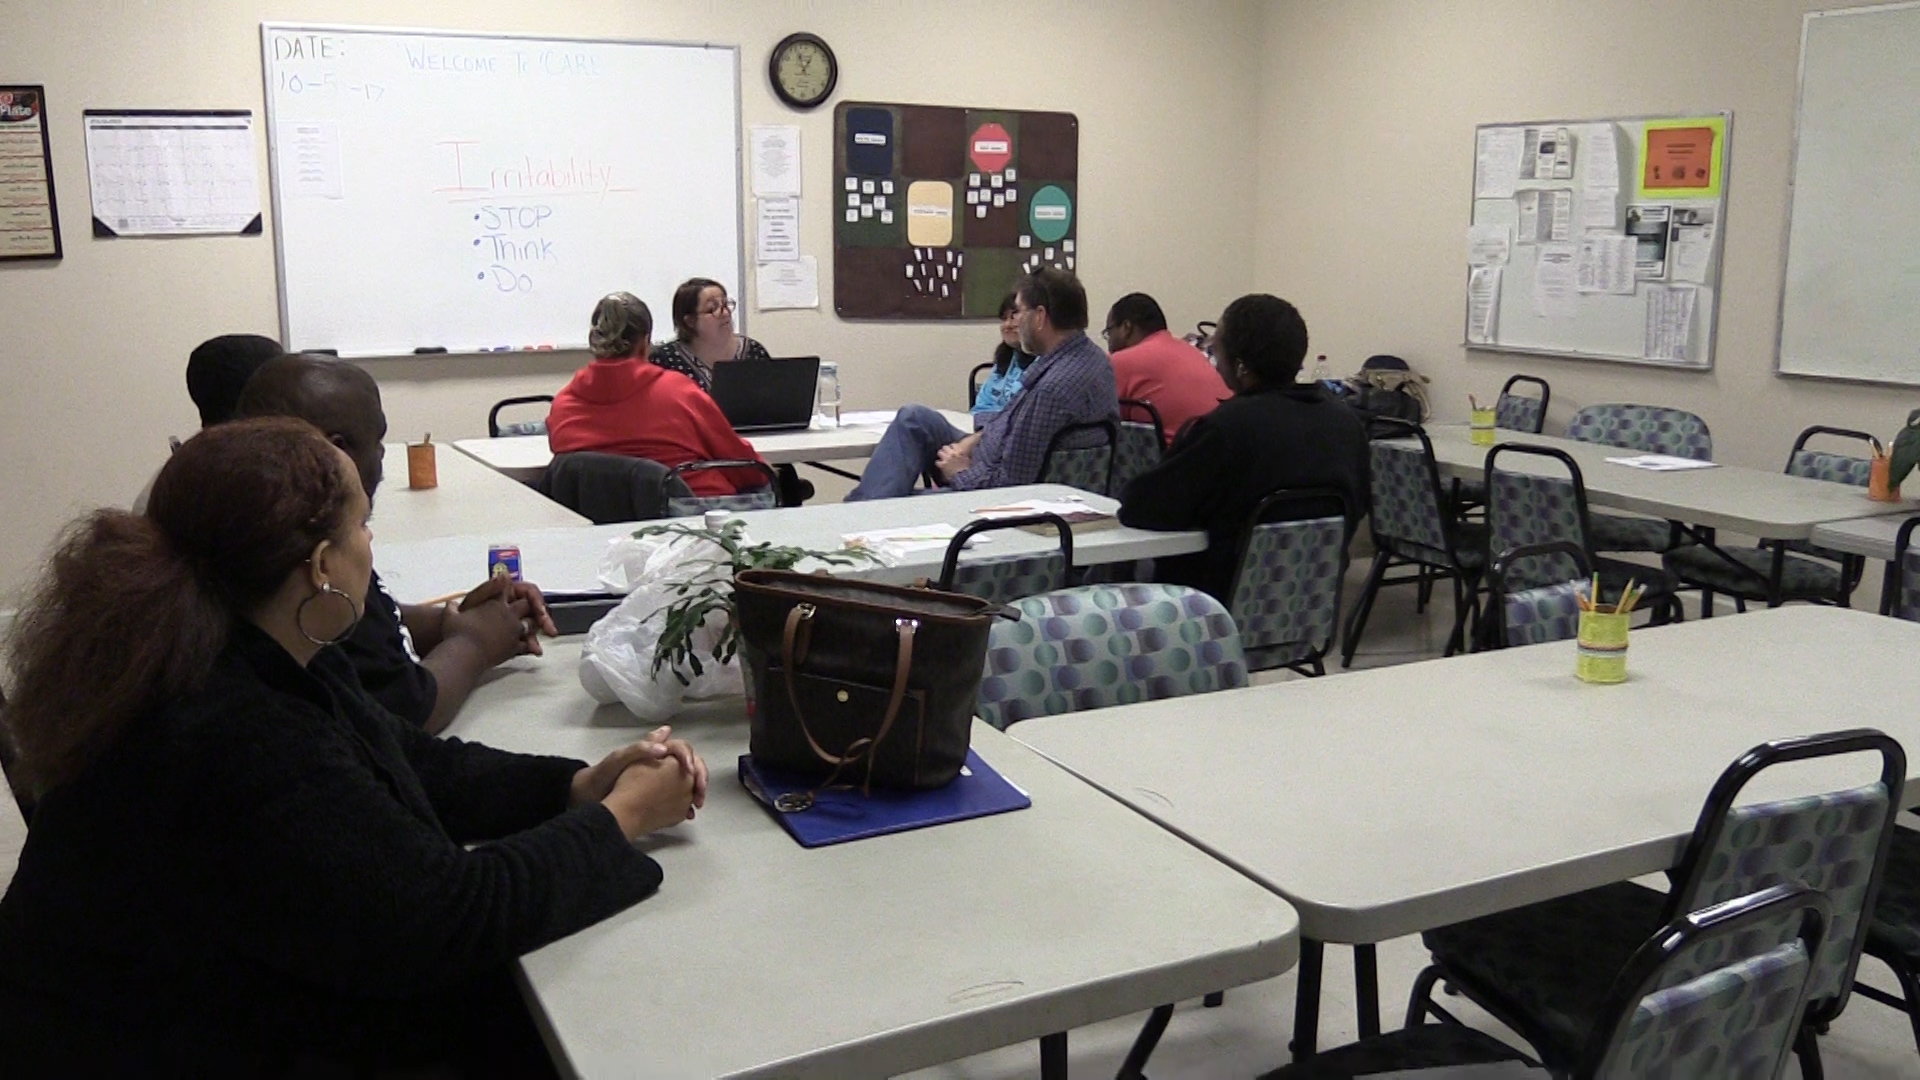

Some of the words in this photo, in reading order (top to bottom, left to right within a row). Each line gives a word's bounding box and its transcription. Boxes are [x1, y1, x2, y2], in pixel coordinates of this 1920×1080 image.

[274, 35, 345, 62] DATE:
[403, 42, 497, 73] WELCOME
[434, 139, 613, 205] Irritability
[480, 204, 554, 231] STOP
[481, 233, 560, 266] Think
[490, 263, 534, 294] Do
